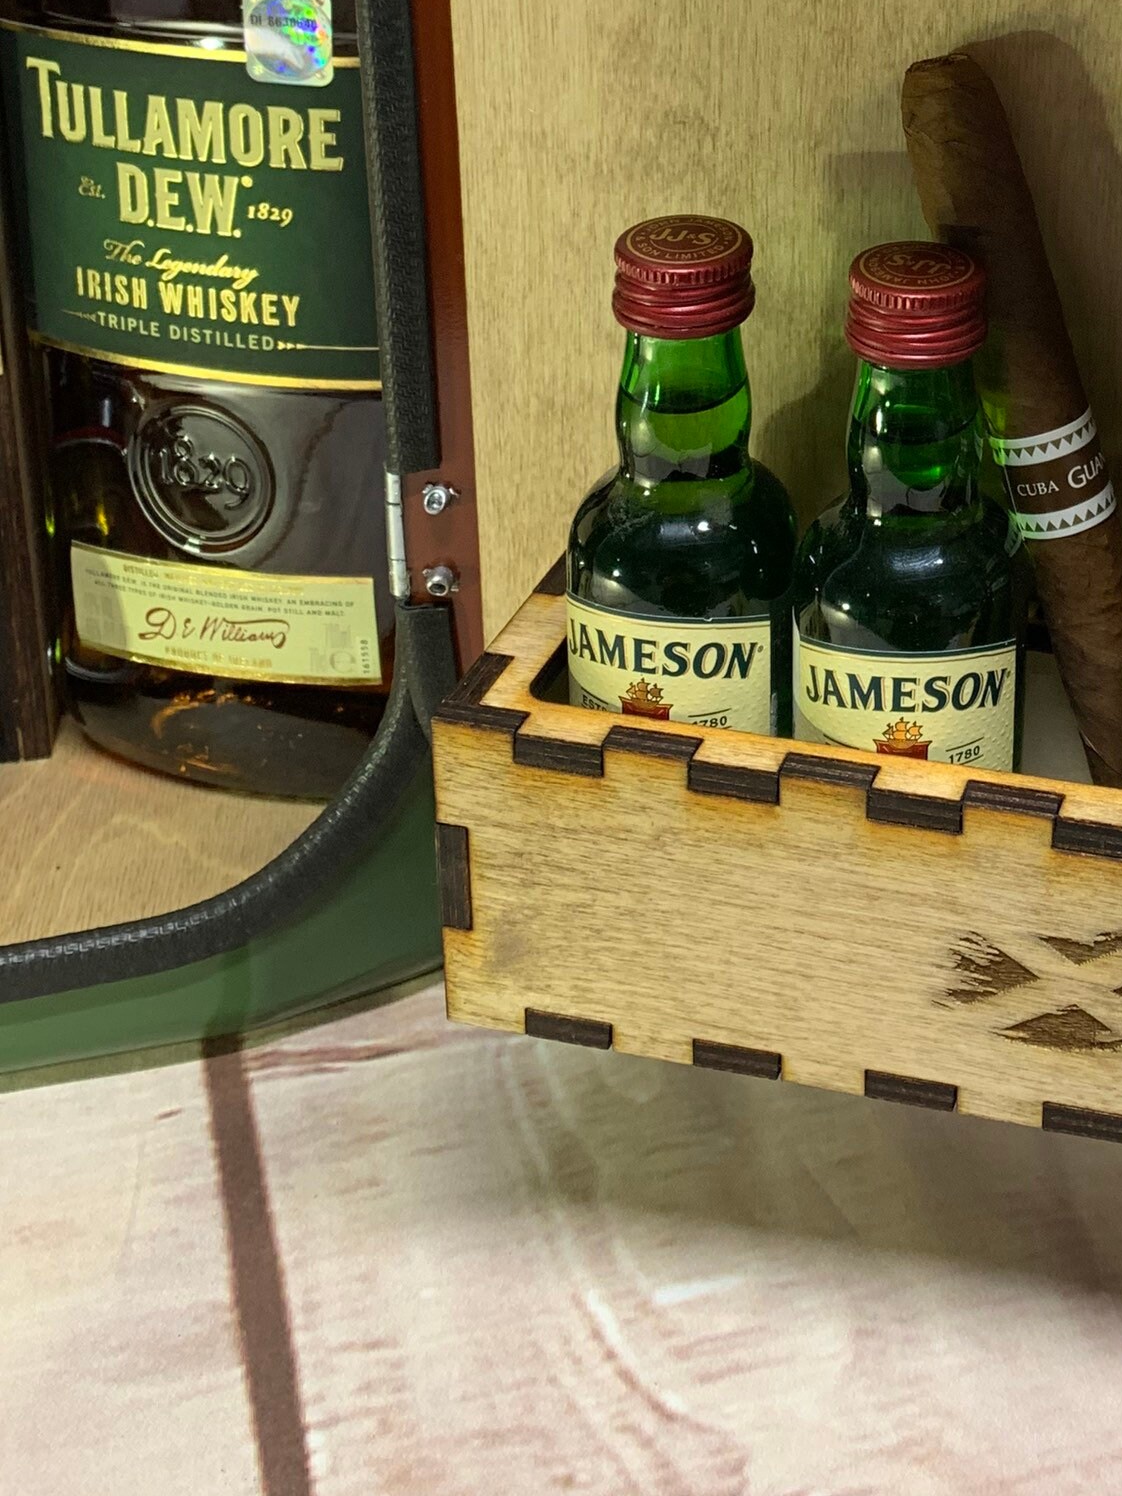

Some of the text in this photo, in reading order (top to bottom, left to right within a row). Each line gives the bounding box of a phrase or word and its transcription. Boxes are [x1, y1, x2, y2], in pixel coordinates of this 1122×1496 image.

[26, 57, 344, 172] TULLAMORE
[247, 202, 293, 227] 1829
[103, 239, 260, 290] The Legendary
[76, 266, 300, 327] IRISH WHISKEY
[97, 312, 275, 351] TRIPLE DISTILLED
[1016, 480, 1060, 497] CUBA
[569, 618, 758, 679] JAMESON
[805, 664, 1008, 714] JAMESON
[948, 745, 981, 764] 1780
